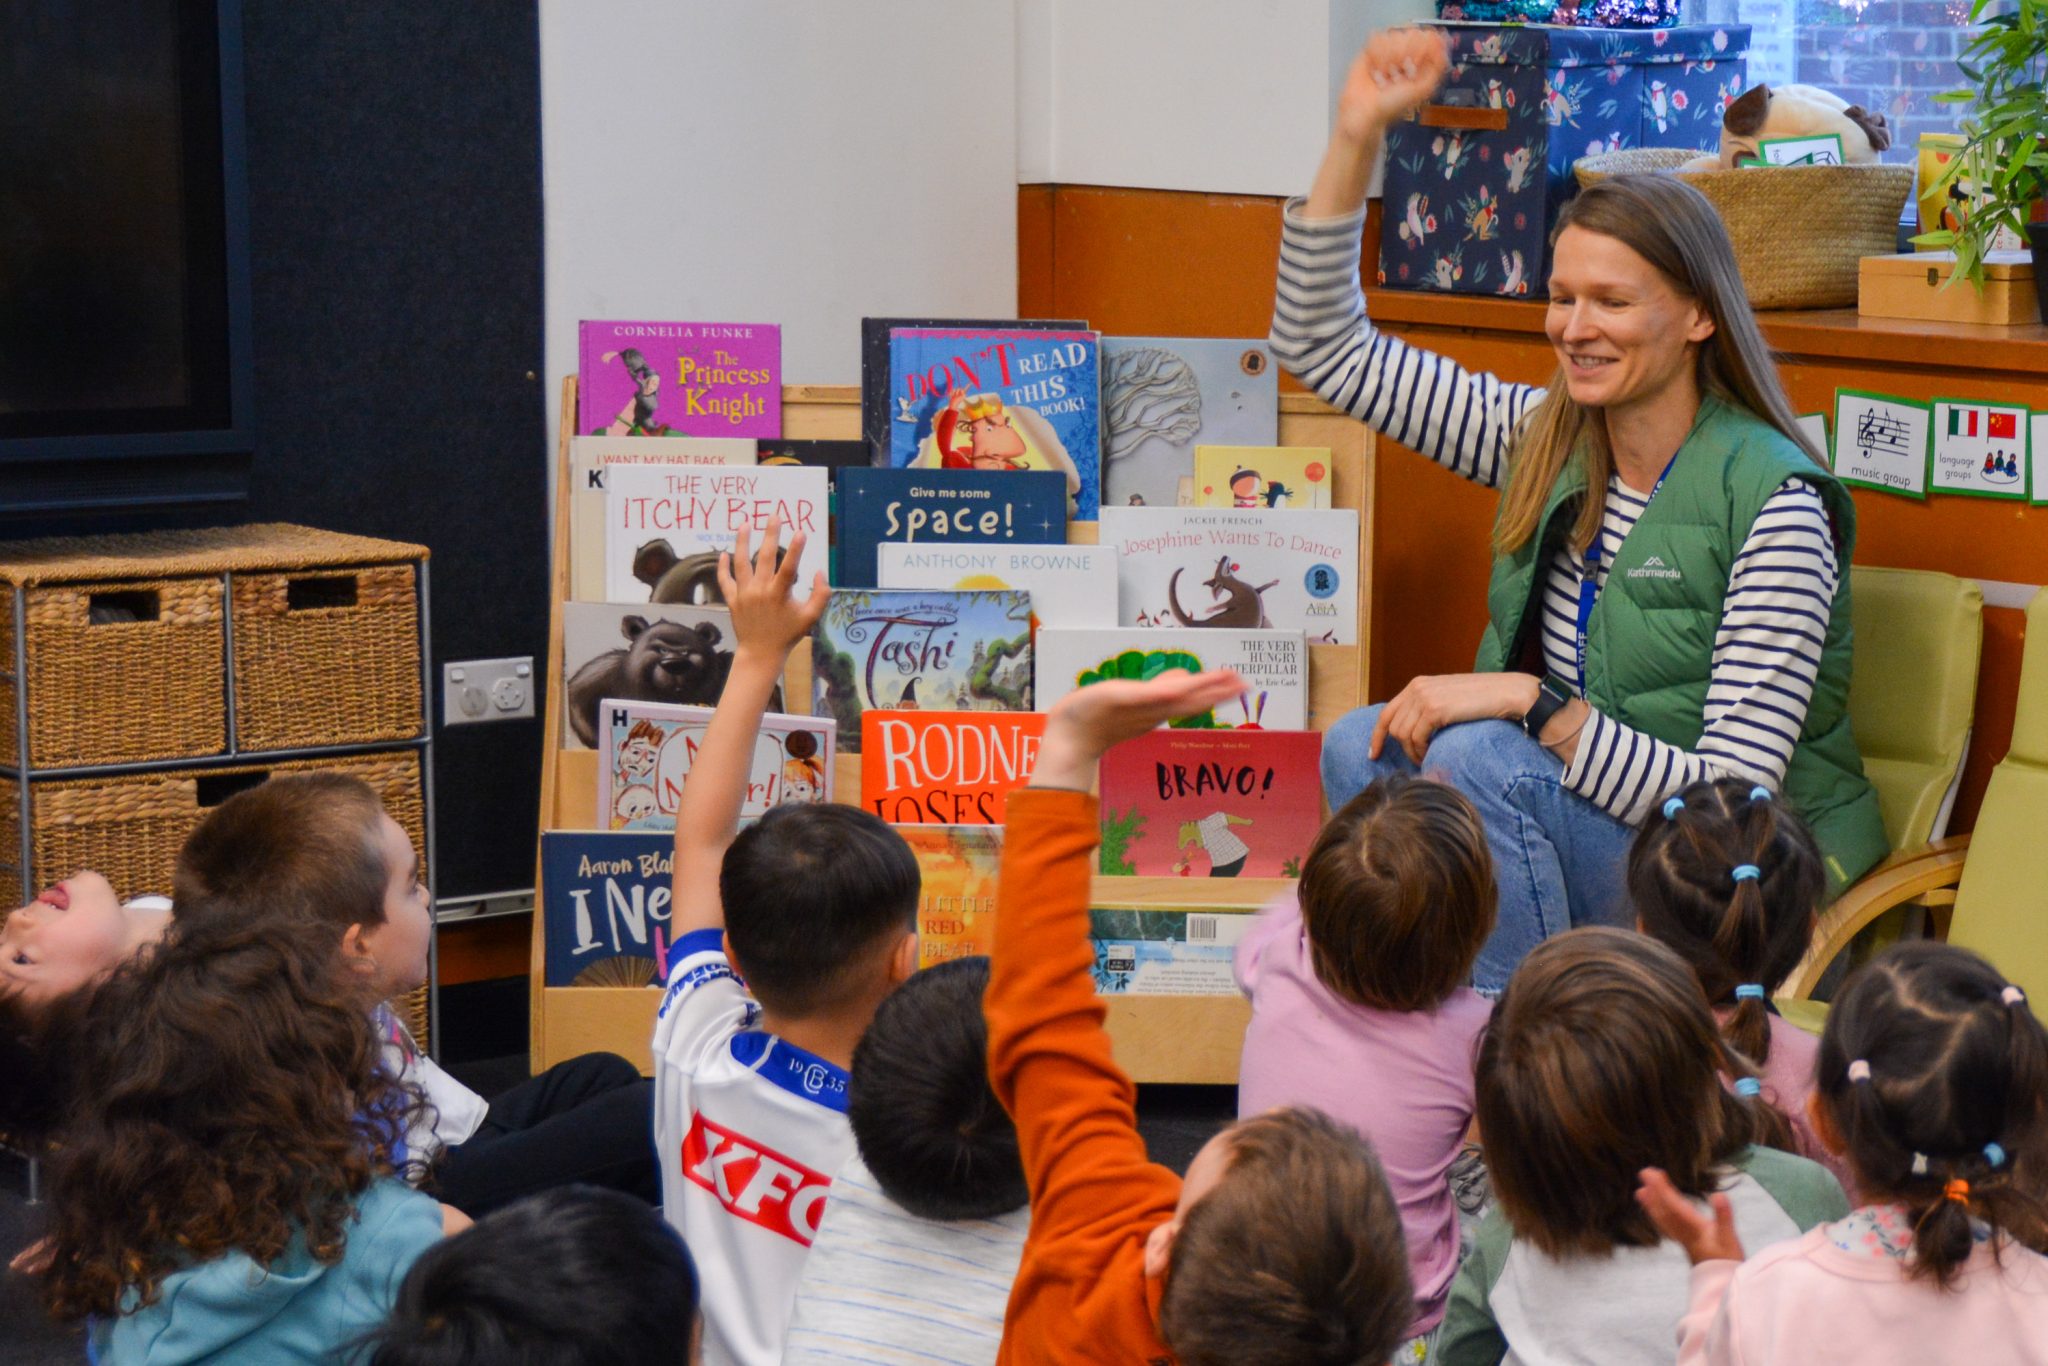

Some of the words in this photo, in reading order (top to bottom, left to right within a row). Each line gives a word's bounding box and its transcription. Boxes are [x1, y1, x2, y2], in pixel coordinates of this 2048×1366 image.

[614, 326, 693, 338] CORNELIA
[702, 327, 753, 339] FUNKE
[714, 350, 739, 366] The
[678, 356, 770, 386] Princess
[905, 342, 1018, 402] DON'T
[1017, 342, 1087, 375] READ
[1010, 375, 1067, 405] THIS
[686, 388, 765, 424] Knight
[1040, 397, 1085, 417] BOOK!
[604, 455, 639, 465] WANT
[644, 455, 662, 465] MY
[667, 455, 689, 465] HAT
[1939, 453, 1975, 468] language
[588, 469, 604, 488] K
[1851, 466, 1880, 480] music
[1884, 472, 1911, 487] group
[1945, 469, 1972, 480] groups
[665, 475, 702, 495] THE
[711, 475, 758, 495] VERY
[910, 487, 935, 499] Give
[939, 489, 957, 498] me
[959, 489, 991, 499] some
[624, 497, 717, 530] ITCHY
[727, 499, 815, 532] BEAR
[885, 501, 1014, 543] Space!
[1184, 517, 1217, 525] JACKIE
[1222, 517, 1262, 525] FRENCH
[1123, 530, 1202, 556] Josephine
[1209, 530, 1260, 546] Wants
[1265, 531, 1285, 548] To
[1291, 535, 1343, 560] Dance
[904, 554, 997, 569] ANTHONY
[1010, 555, 1091, 570] BROWNE
[1627, 567, 1681, 579] Kathmandu
[1241, 640, 1264, 651] THE
[1268, 640, 1298, 651] VERY
[1578, 632, 1587, 671] STAFF
[846, 611, 959, 710] Tashi
[1250, 652, 1298, 663] HUNGRY
[612, 709, 628, 727] H
[879, 720, 1043, 791] RODNE
[1156, 761, 1274, 800] BRAVO!
[578, 854, 633, 878] Aaron
[637, 850, 675, 878] Bla
[925, 896, 994, 912] LITTLE
[569, 889, 603, 955] I
[606, 877, 672, 952] Ne
[925, 920, 965, 935] RED
[789, 1058, 803, 1073] 19
[826, 1077, 845, 1092] 35
